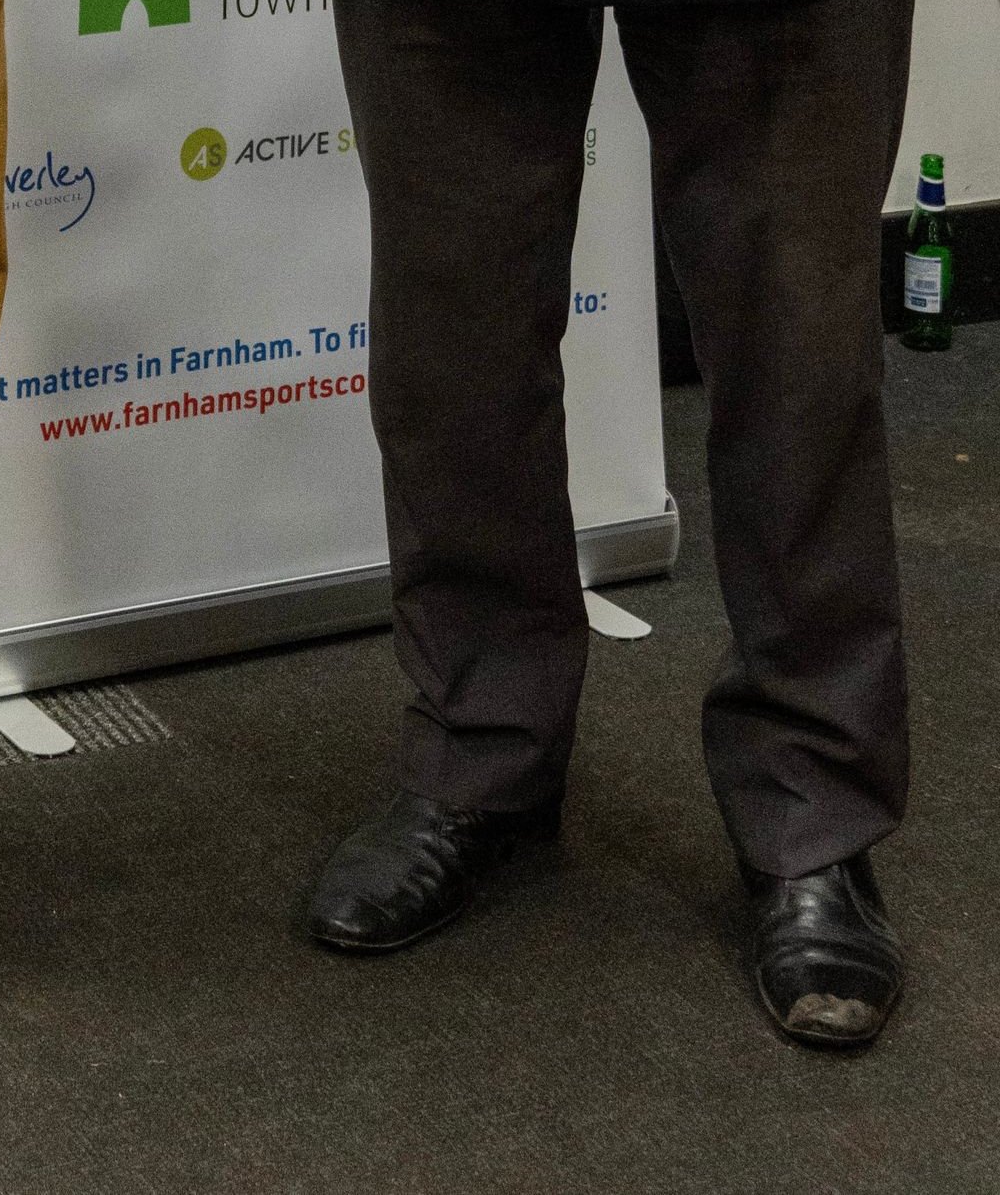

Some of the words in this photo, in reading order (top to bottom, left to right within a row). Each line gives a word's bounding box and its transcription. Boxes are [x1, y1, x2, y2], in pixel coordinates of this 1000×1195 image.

[235, 131, 329, 165] ACTIVE
[25, 192, 84, 208] COUNCIL
[573, 292, 607, 315] to:
[16, 359, 129, 400] matters
[136, 353, 161, 380] in
[169, 337, 302, 374] Farnham.
[309, 327, 341, 355] To
